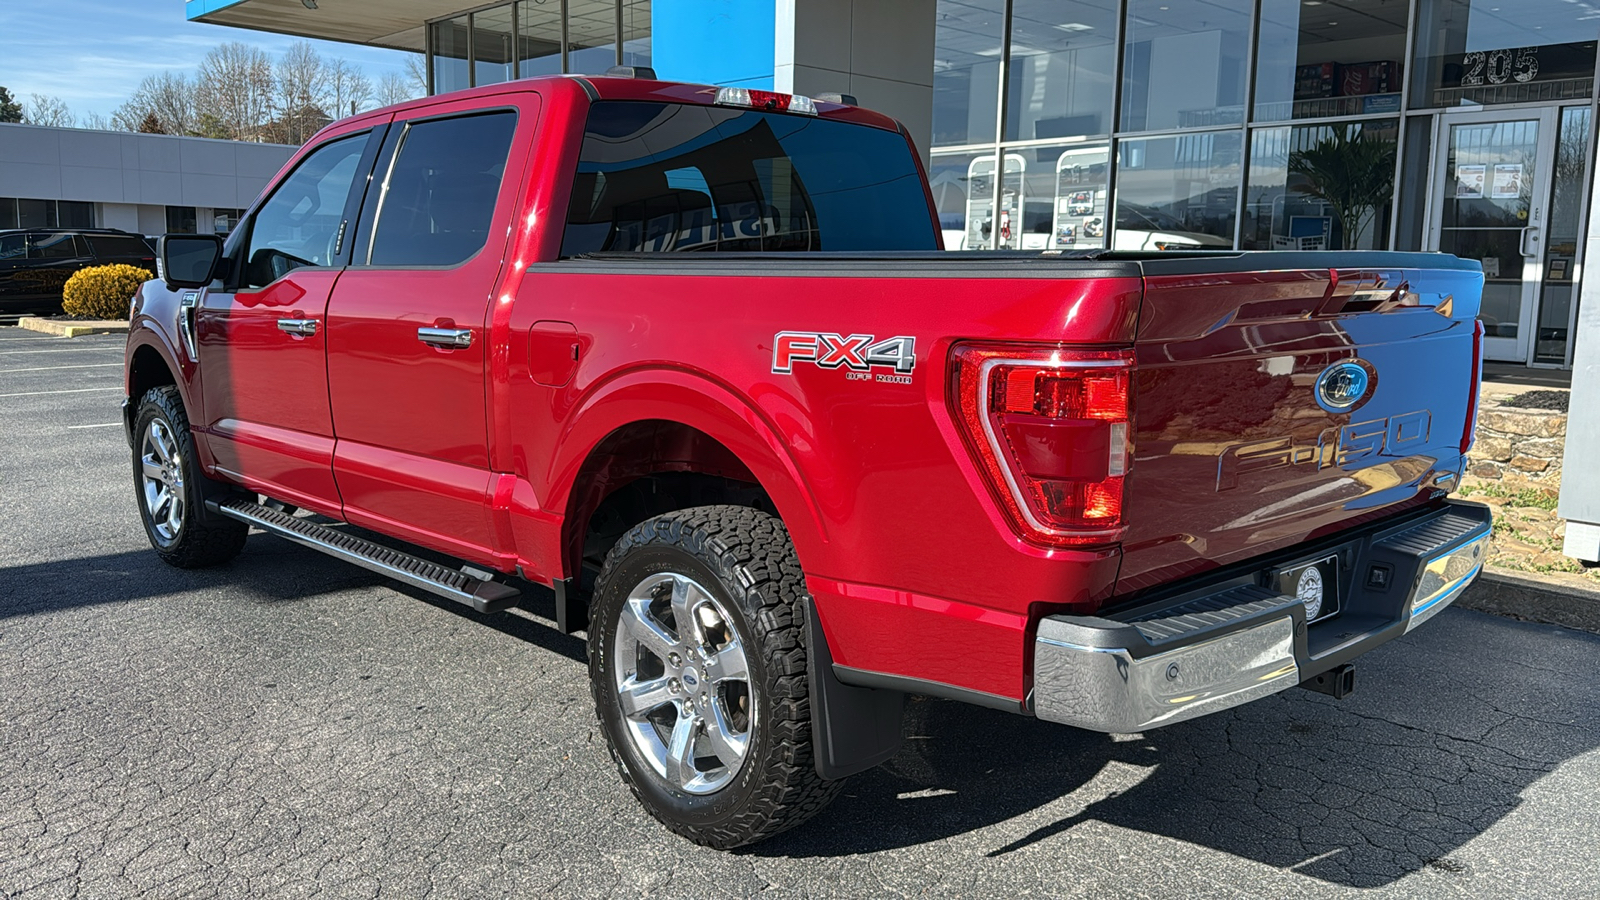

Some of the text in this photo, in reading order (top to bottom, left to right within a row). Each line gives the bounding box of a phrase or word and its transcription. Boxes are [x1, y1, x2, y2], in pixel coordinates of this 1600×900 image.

[1461, 47, 1539, 87] 205
[771, 330, 916, 375] FX4
[846, 372, 912, 384] OFF ROAD
[1216, 409, 1433, 493] F-150
